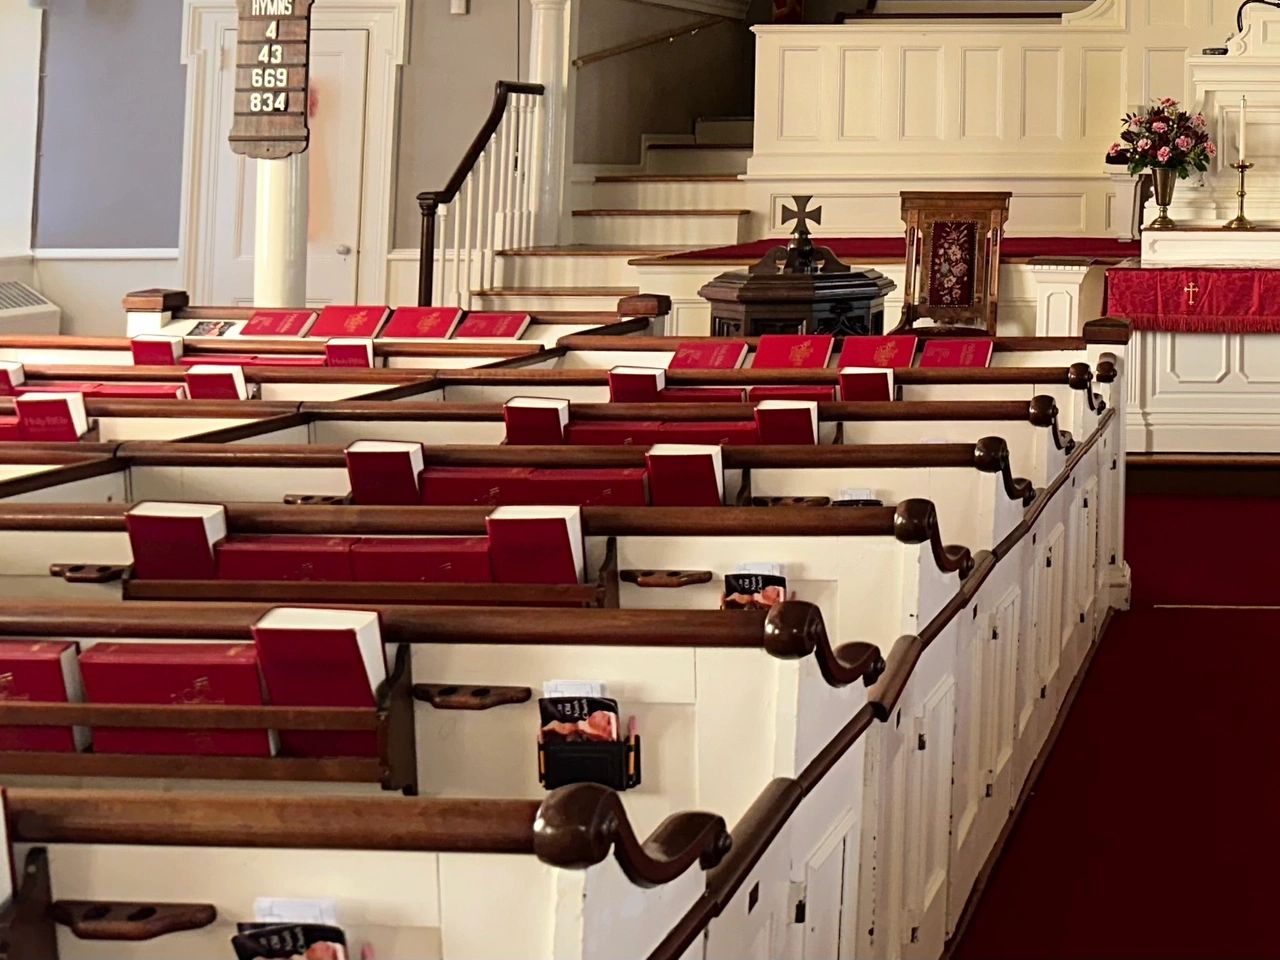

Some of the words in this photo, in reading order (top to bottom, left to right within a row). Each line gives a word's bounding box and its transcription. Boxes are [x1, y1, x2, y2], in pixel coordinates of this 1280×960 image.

[265, 21, 276, 40] 4
[258, 45, 283, 64] 43
[252, 68, 288, 87] 669
[250, 92, 286, 112] 834
